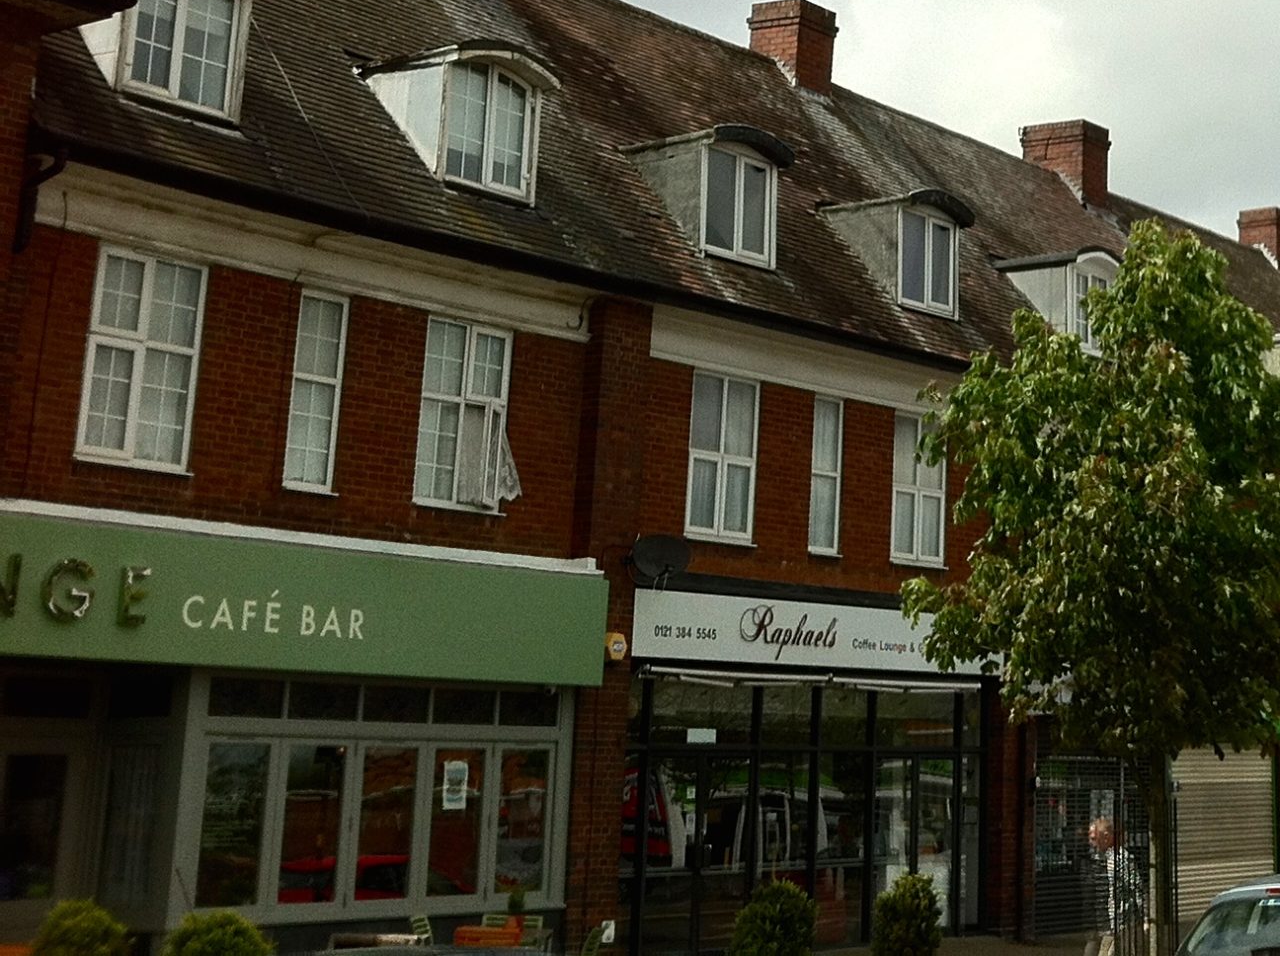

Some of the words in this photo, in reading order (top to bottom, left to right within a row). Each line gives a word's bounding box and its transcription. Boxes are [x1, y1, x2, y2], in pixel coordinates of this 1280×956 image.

[182, 590, 281, 634] CAFÉ
[300, 605, 364, 640] BAR
[654, 624, 672, 637] 0121
[676, 626, 692, 639] 384
[696, 627, 717, 641] 5545
[852, 637, 877, 650] Coffee
[880, 640, 907, 654] Lounge
